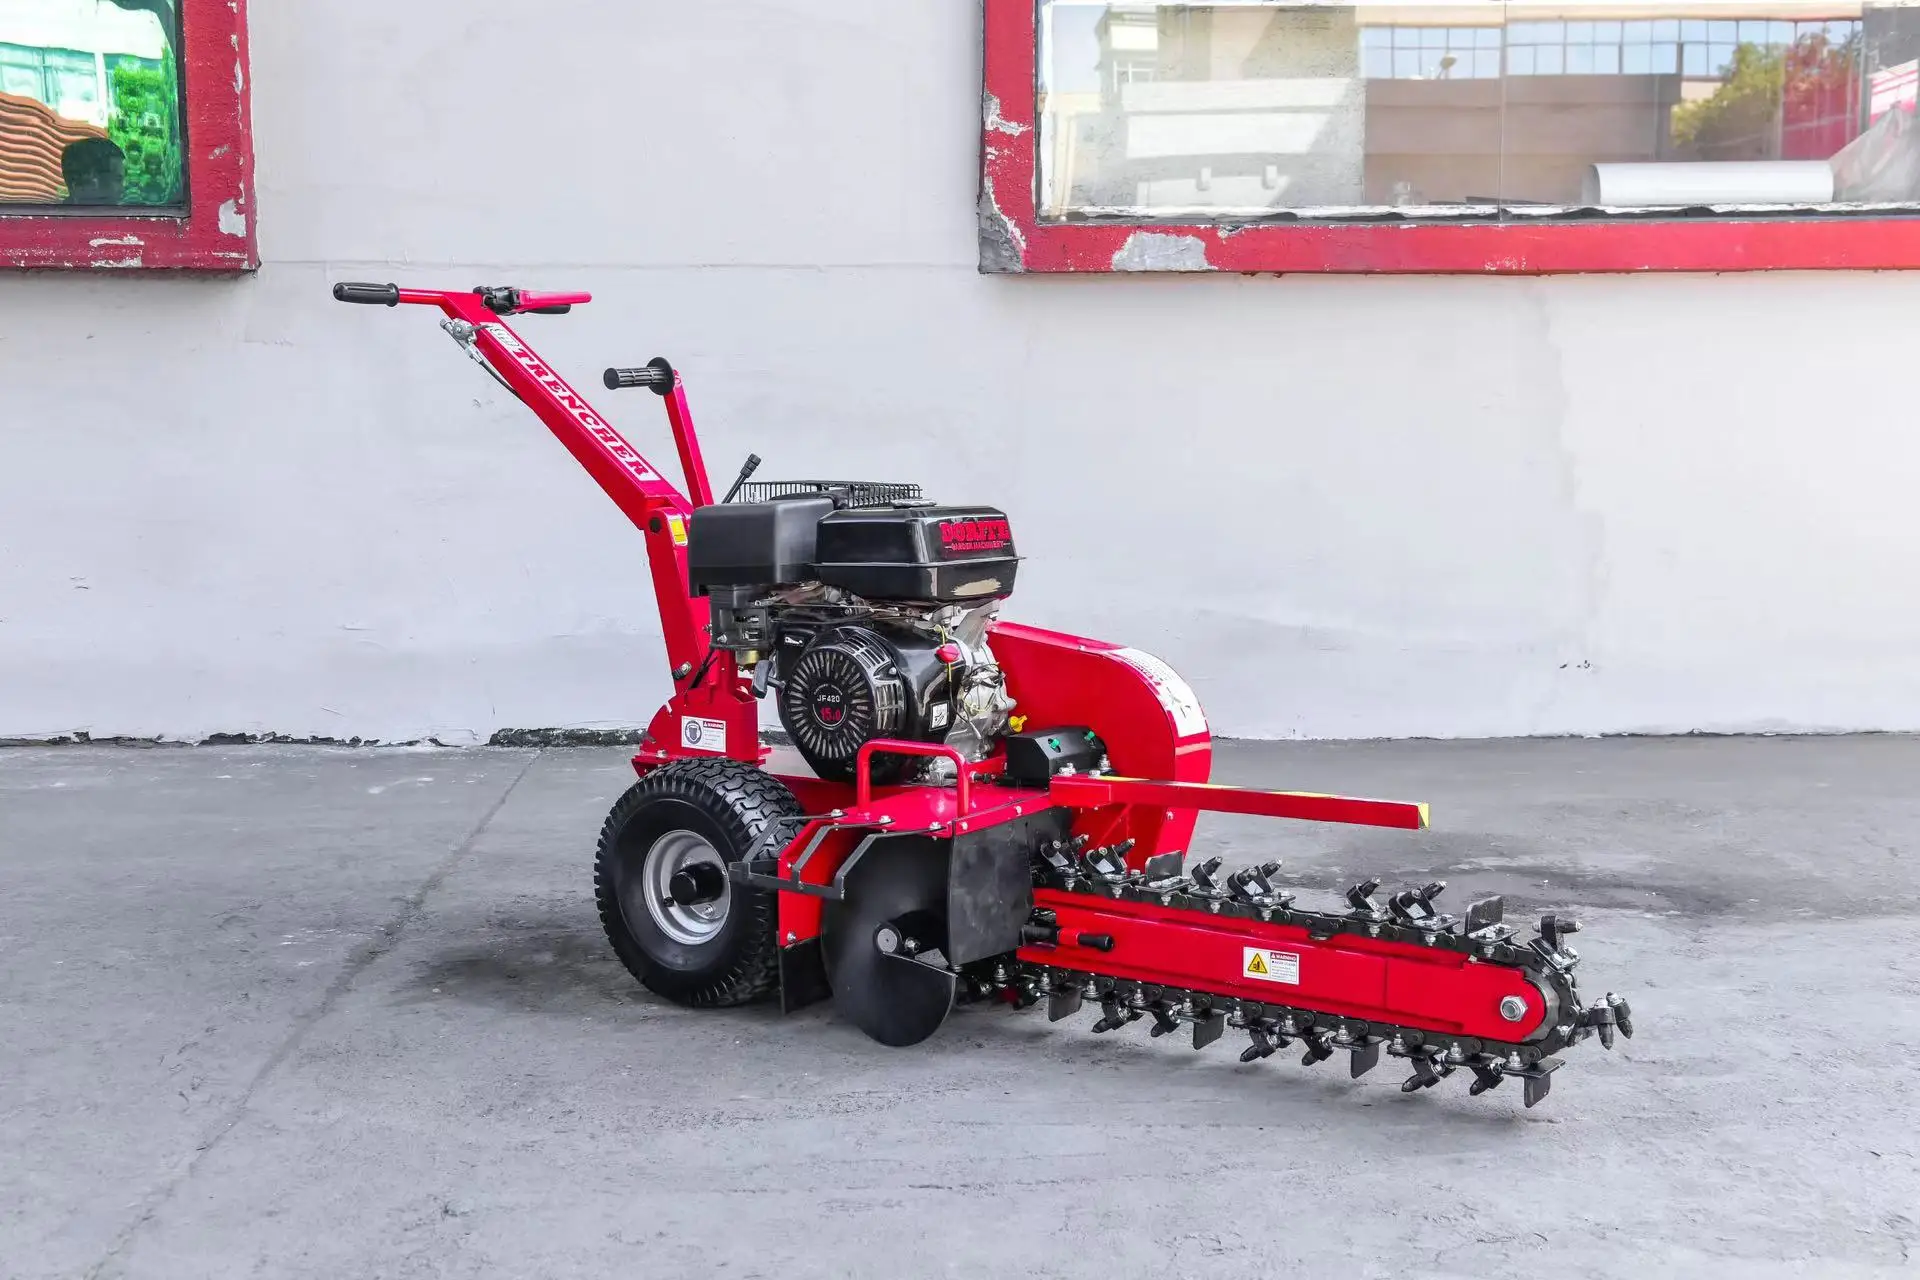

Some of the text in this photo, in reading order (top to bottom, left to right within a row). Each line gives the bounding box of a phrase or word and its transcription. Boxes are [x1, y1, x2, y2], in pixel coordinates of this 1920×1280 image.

[512, 348, 650, 477] TRENCHER
[817, 695, 841, 703] JF420
[820, 707, 841, 721] 15.0
[1275, 953, 1297, 961] WARNING
